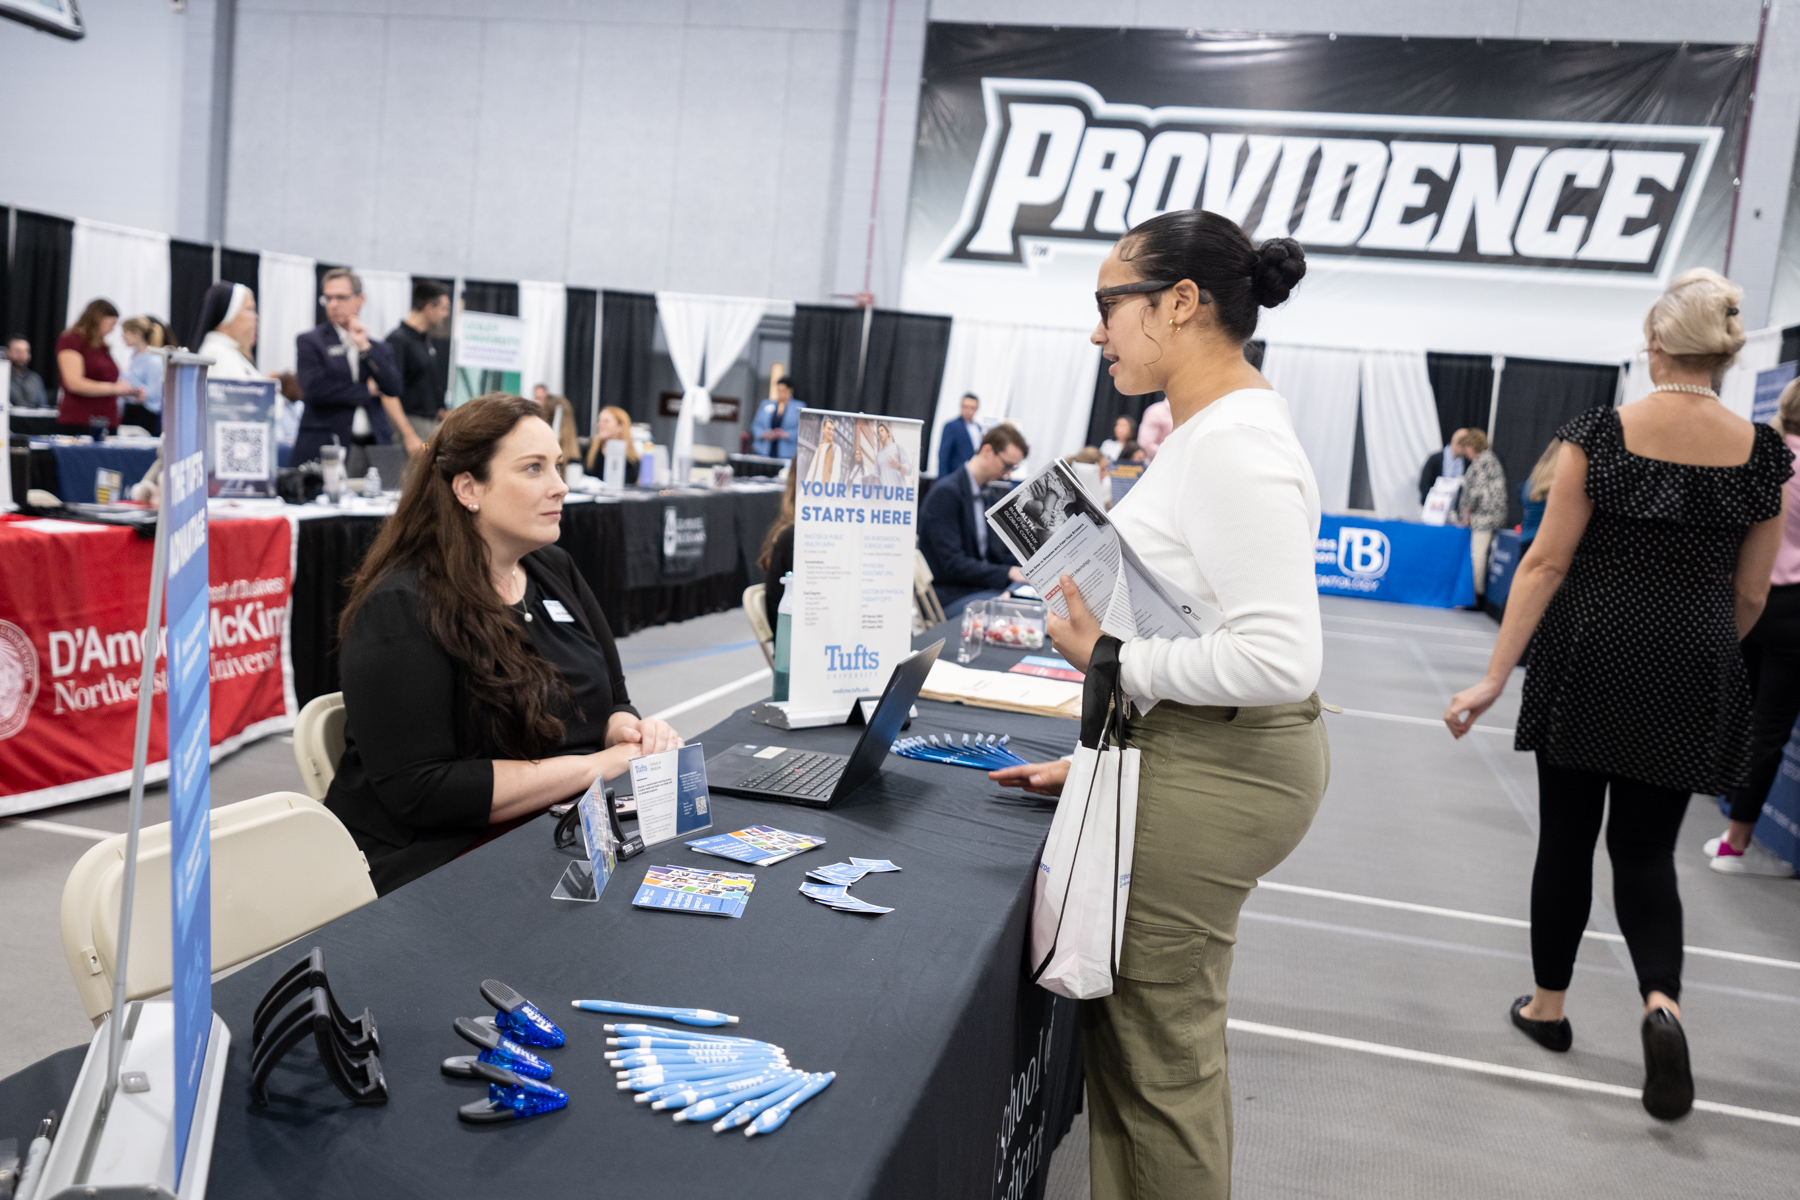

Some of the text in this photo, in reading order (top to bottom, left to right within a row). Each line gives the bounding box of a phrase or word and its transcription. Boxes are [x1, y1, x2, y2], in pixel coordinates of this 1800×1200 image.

[967, 103, 1687, 263] PROVIDENCE
[801, 480, 915, 502] YOUR FUTURE
[801, 506, 912, 525] STARTS HERE
[1008, 506, 1038, 544] BUILD HEALTHY
[1013, 502, 1035, 530] HEALTH
[1003, 510, 1037, 553] GLOBAL COMMUN
[1315, 573, 1379, 593] ONTOLOGY
[825, 644, 879, 671] Tufts
[826, 671, 878, 680] UNIVERSITY
